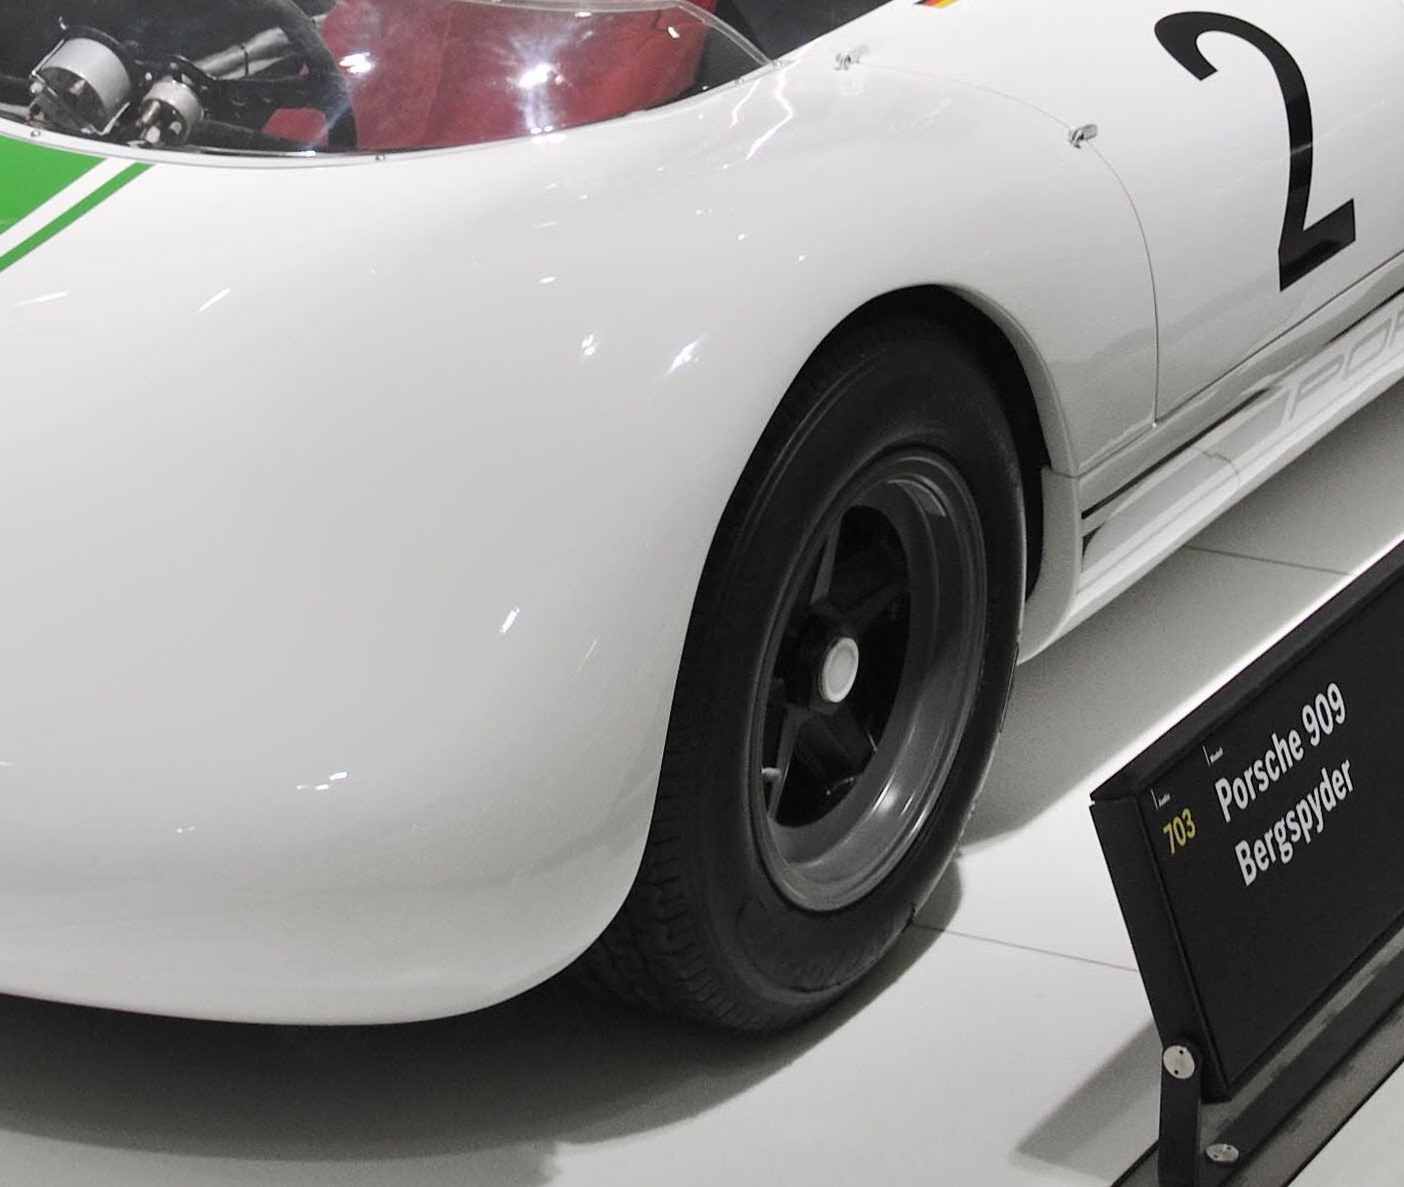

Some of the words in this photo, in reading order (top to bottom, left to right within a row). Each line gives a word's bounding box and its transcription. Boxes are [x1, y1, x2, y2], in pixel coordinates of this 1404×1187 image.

[1154, 10, 1357, 292] 2
[1215, 730, 1304, 823] Porsche
[1302, 683, 1345, 746] 909
[1163, 809, 1195, 854] 703
[1235, 759, 1353, 886] Bergspyder
